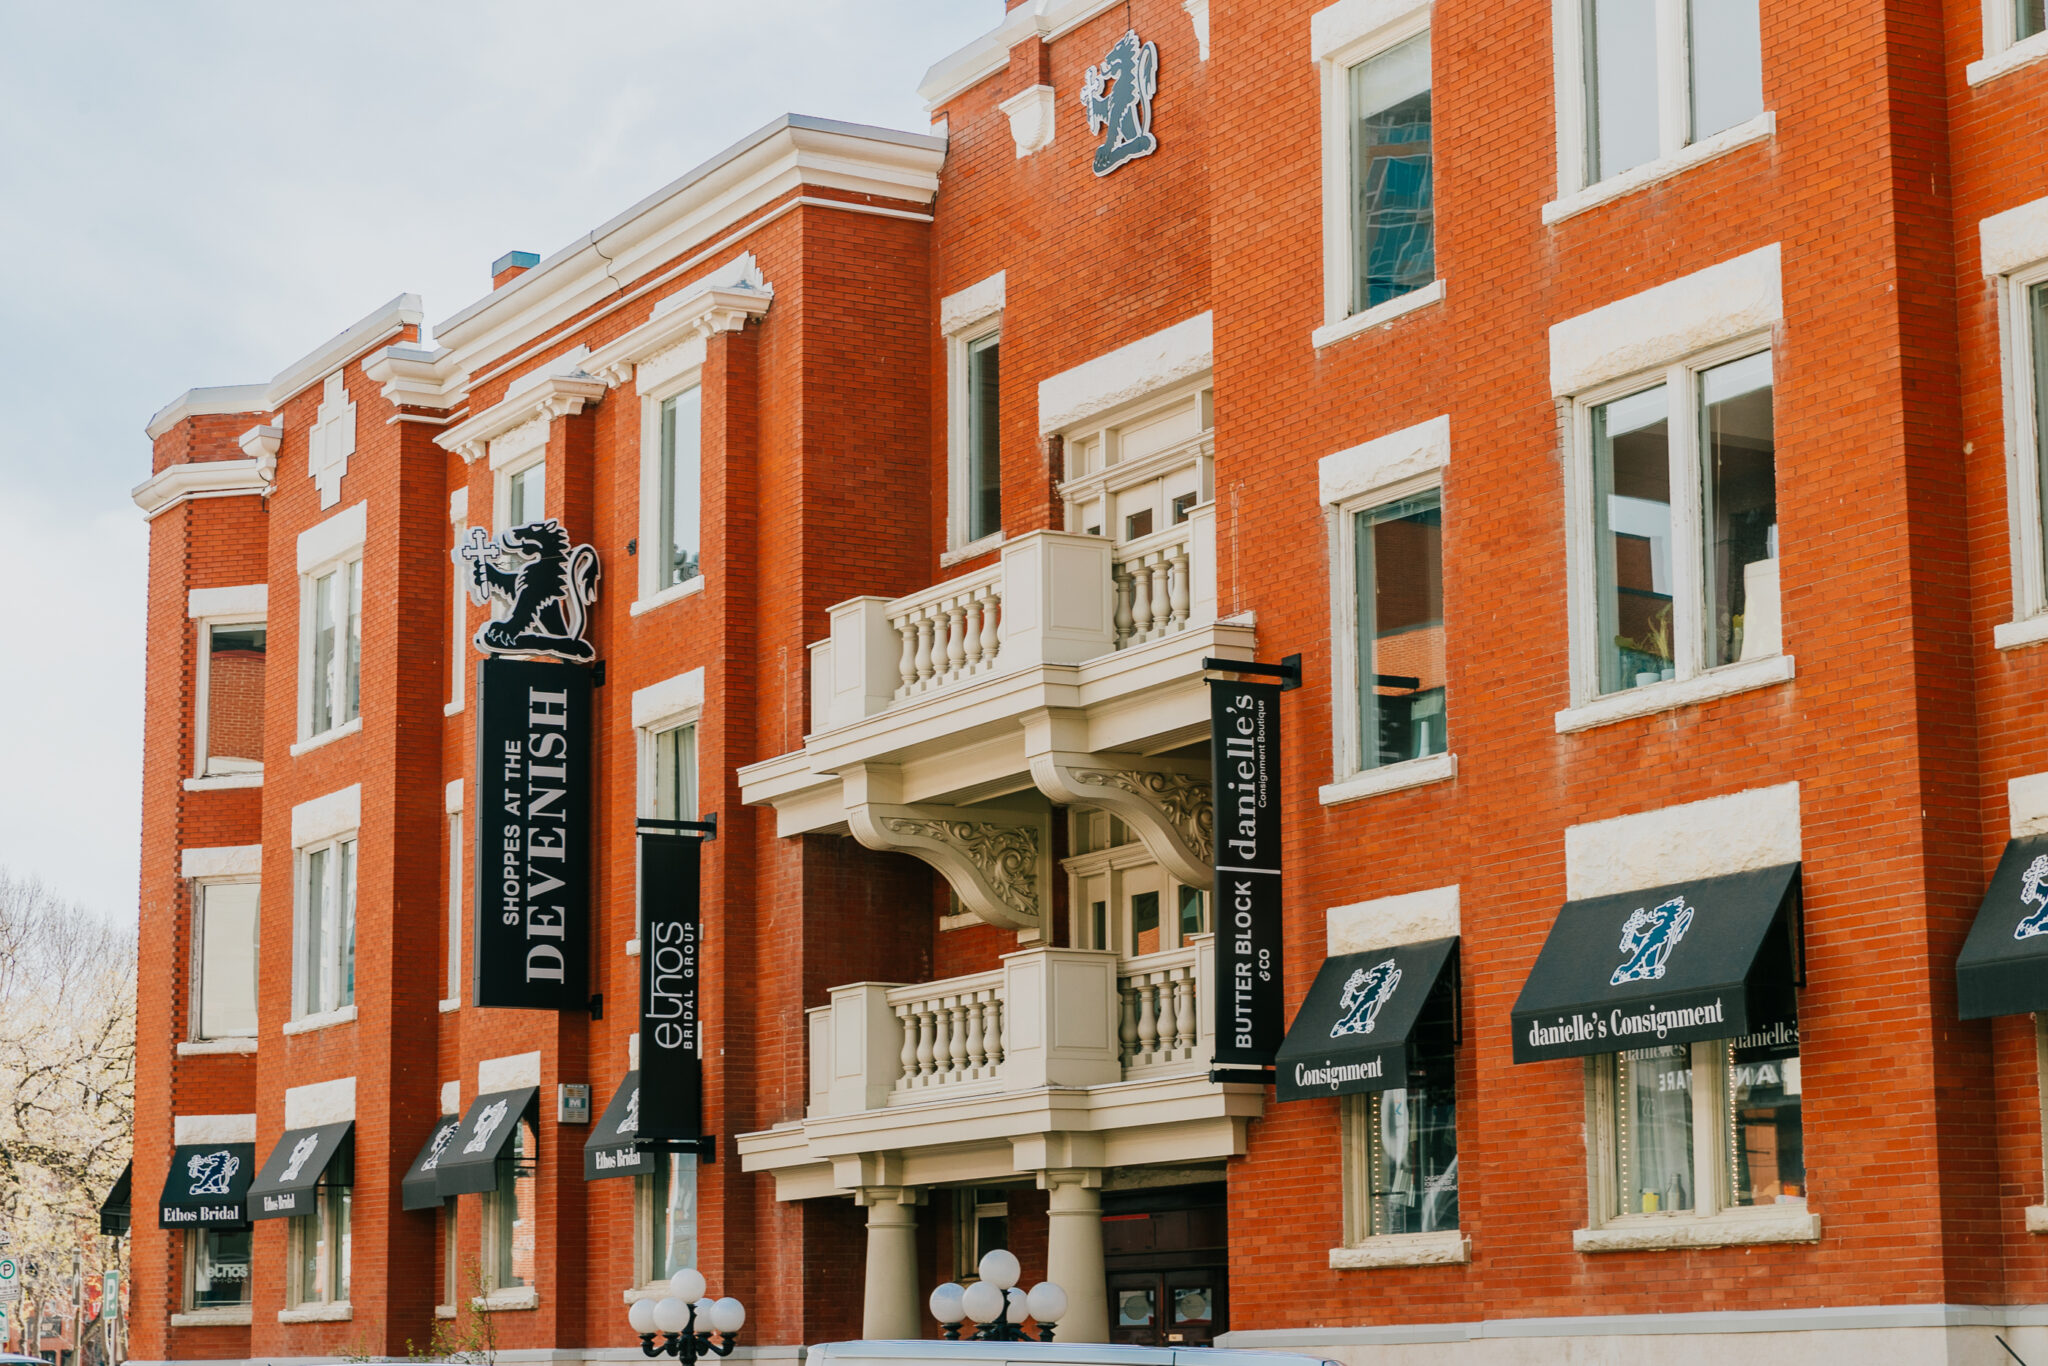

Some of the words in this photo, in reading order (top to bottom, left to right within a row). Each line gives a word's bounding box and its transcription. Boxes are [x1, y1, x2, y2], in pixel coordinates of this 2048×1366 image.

[1257, 699, 1268, 743] Boutique
[505, 740, 522, 782] THE
[1226, 694, 1257, 861] danielle's
[1258, 744, 1269, 808] Consignment
[505, 787, 522, 817] AT
[526, 686, 568, 985] DEVENISH
[503, 824, 521, 926] SHOPPES
[1235, 881, 1252, 955] BLOCK
[684, 922, 694, 978] GROUP
[645, 921, 684, 1049] ethos
[1235, 962, 1252, 1049] BUTTER
[684, 990, 694, 1050] BRIDAL
[1529, 1011, 1607, 1047] danielle's
[1610, 997, 1724, 1039] Consignment
[1295, 1055, 1383, 1090] Consignment
[595, 1151, 616, 1170] Ethos
[164, 1207, 197, 1222] Ethos
[200, 1205, 239, 1221] Bridal
